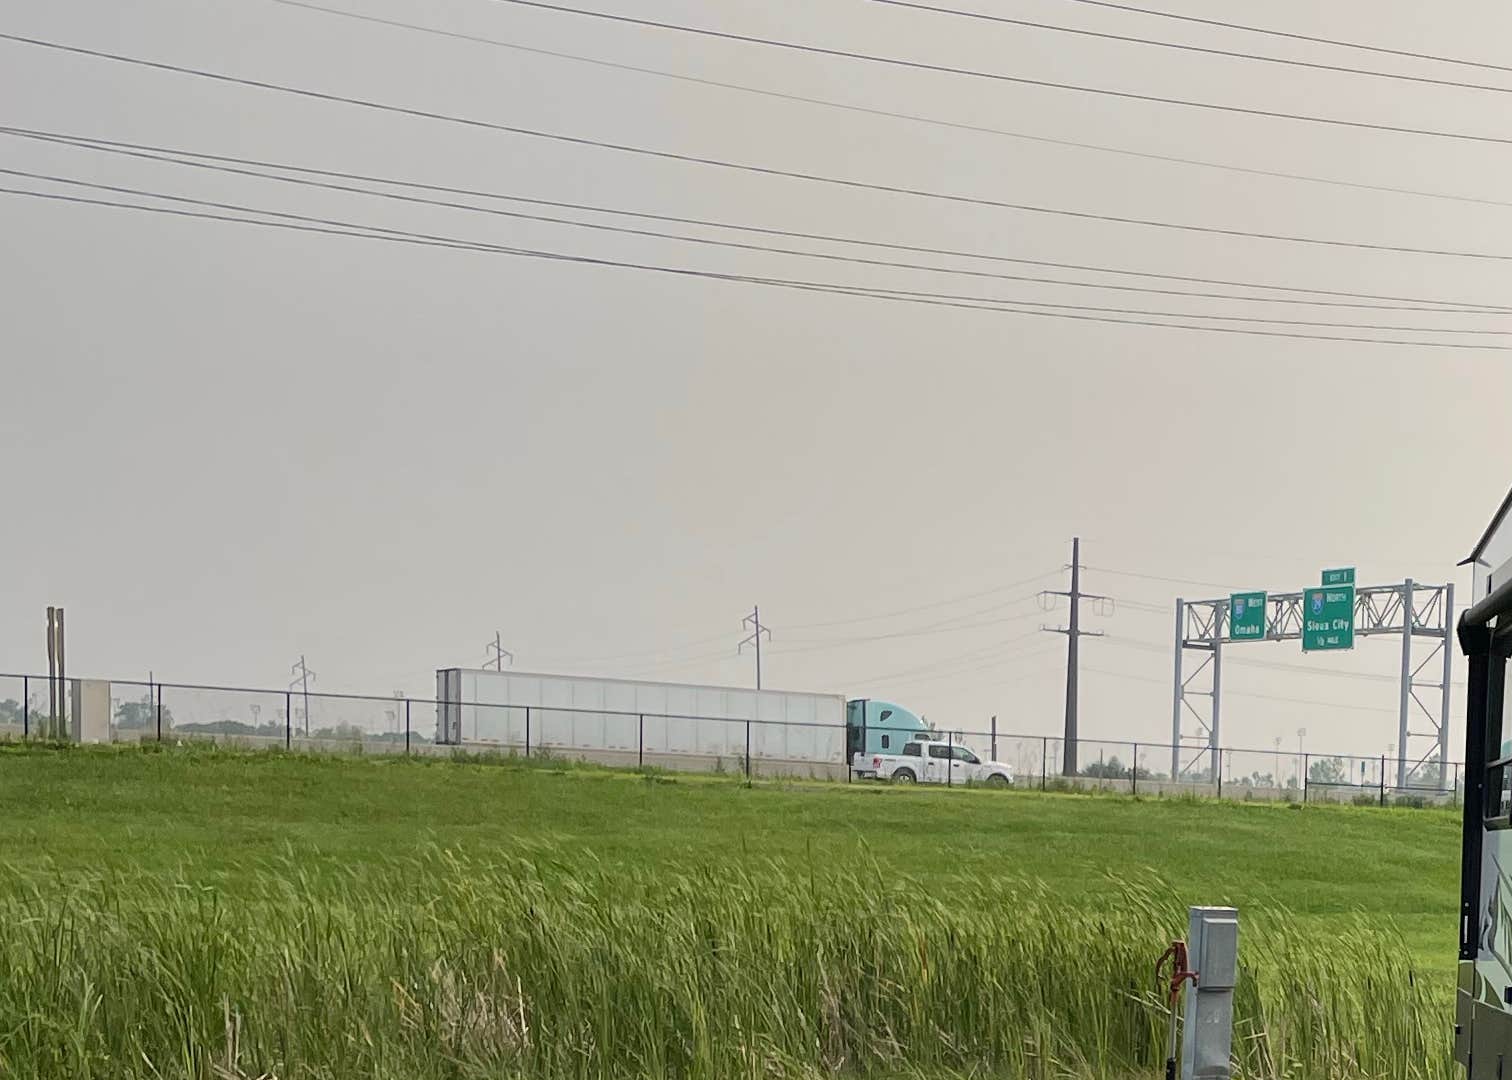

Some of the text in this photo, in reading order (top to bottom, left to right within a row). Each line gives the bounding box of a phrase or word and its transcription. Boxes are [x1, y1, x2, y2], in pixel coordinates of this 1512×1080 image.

[1235, 624, 1260, 634] Omaha
[1307, 619, 1349, 631] Sioux City
